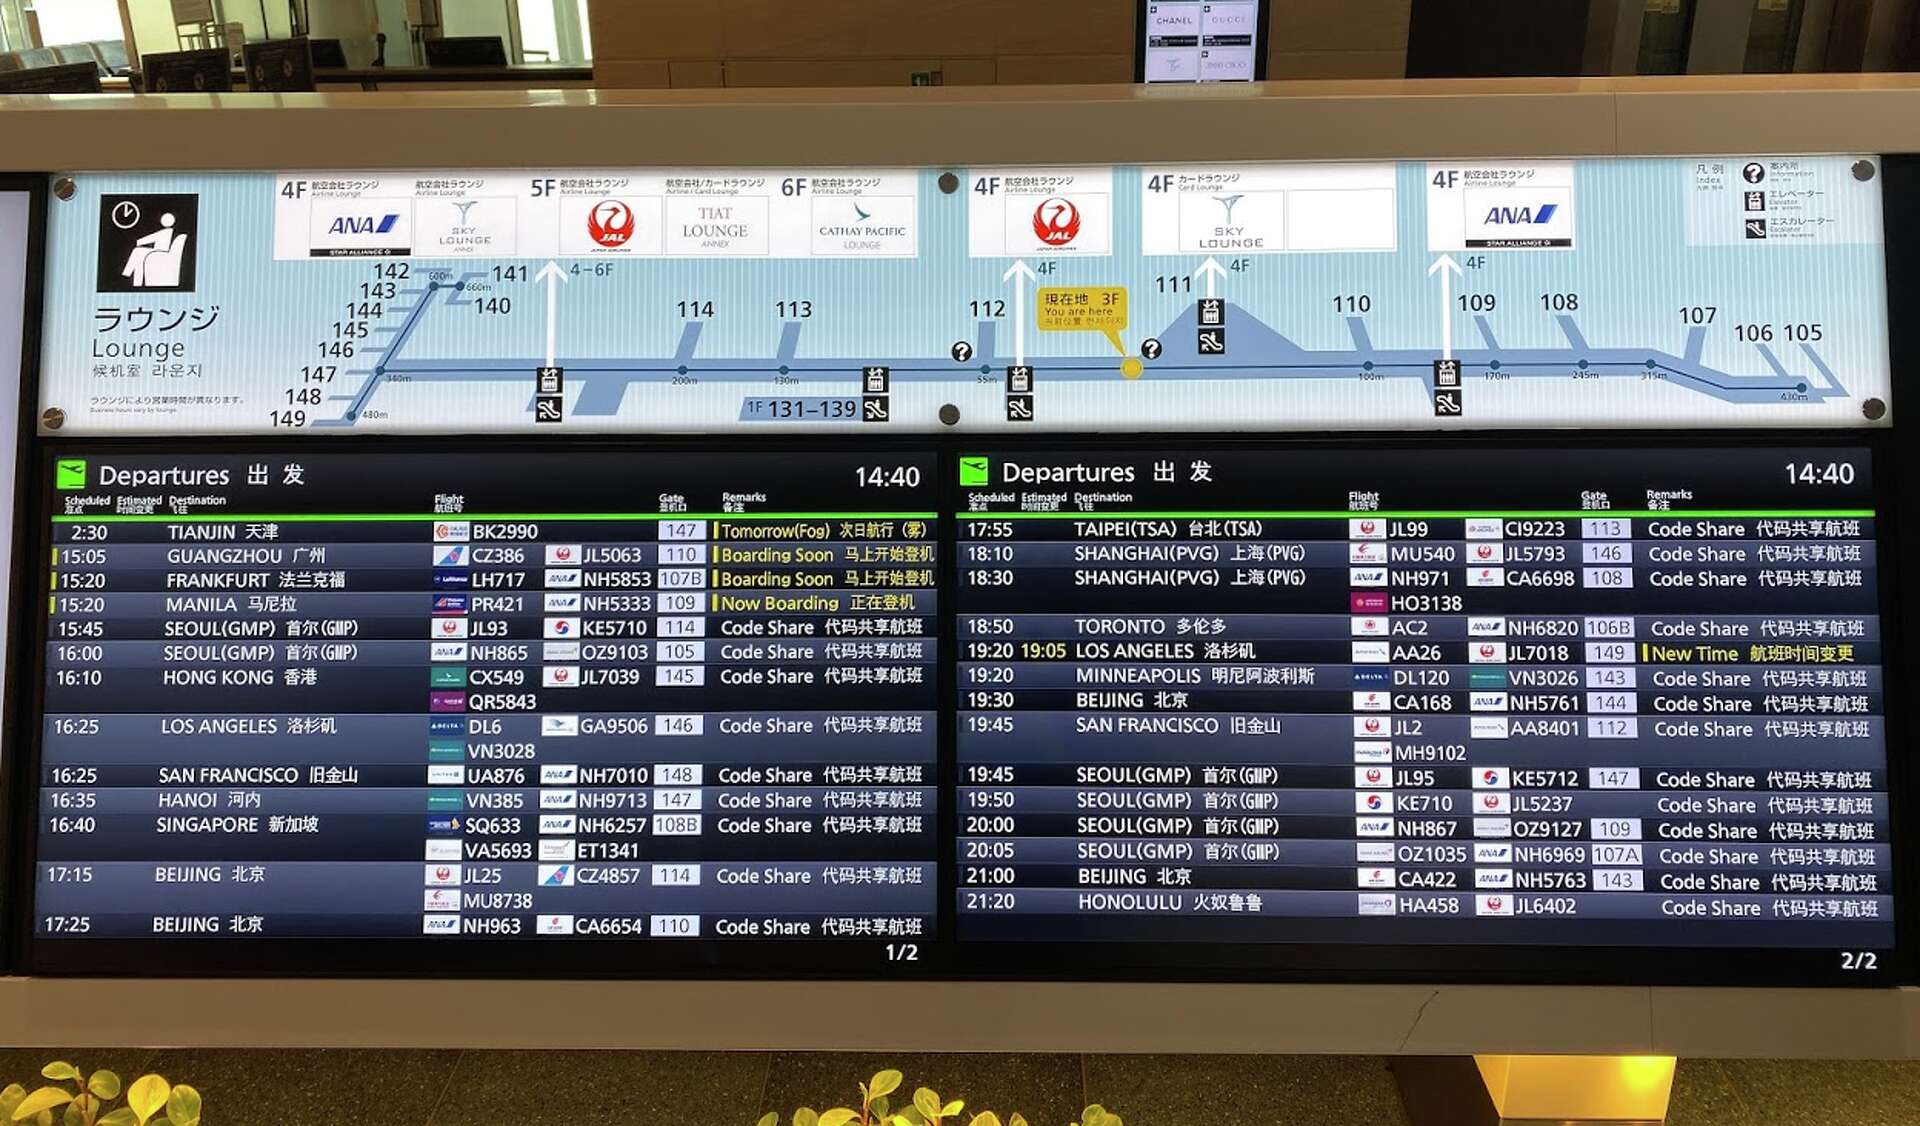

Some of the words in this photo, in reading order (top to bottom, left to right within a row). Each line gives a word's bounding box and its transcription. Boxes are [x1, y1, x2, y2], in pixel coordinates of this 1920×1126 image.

[1156, 17, 1193, 25] CHANEL
[1211, 16, 1246, 24] GUCCI
[1004, 176, 1075, 186] 航空会社ラウンジ
[1178, 173, 1241, 184] カードラウンジ
[1432, 170, 1459, 188] 4F
[1463, 169, 1535, 180] 航空会社ラウンジ
[281, 181, 307, 199] 4F
[311, 180, 380, 190] 航空会社ラウンジ
[415, 179, 485, 189] 航空会社ラウンジ
[531, 179, 556, 197] 5F
[560, 179, 629, 188] 航空会社ラウンジ
[781, 179, 807, 197] 6F
[811, 178, 881, 188] 航空会社ラウンジ
[974, 177, 1000, 195] 4F
[1147, 175, 1174, 193] 4F
[698, 207, 733, 220] TIAT
[1484, 206, 1531, 224] ANA
[328, 217, 375, 234] ANA
[452, 227, 476, 235] SKY
[682, 224, 748, 238] LOUNGE
[819, 227, 862, 236] CATHAY
[865, 227, 906, 236] PACIFIC
[1214, 227, 1245, 237] SKY
[439, 236, 491, 245] LOUNGE
[600, 233, 626, 242] JAL
[700, 239, 730, 248] ANNEX
[1045, 231, 1071, 240] JAL
[1199, 237, 1264, 249] LOUNGE
[843, 240, 881, 250] LOUNGE
[1037, 262, 1057, 276] 4F
[1230, 259, 1250, 273] 4F
[1466, 256, 1485, 270] 4F
[374, 263, 410, 280] 142
[493, 265, 527, 281] 141
[361, 282, 396, 299] 143
[1156, 276, 1191, 293] 111
[475, 298, 511, 315] 140
[1102, 293, 1119, 305] 3F
[1333, 295, 1371, 313] 110
[1458, 294, 1496, 312] 109
[1540, 293, 1579, 311] 108
[347, 303, 383, 319] 144
[677, 301, 714, 318] 114
[776, 301, 812, 318] 113
[969, 300, 1005, 317] 112
[1045, 307, 1064, 316] You
[1088, 307, 1113, 316] here
[1679, 307, 1717, 324] 107
[94, 305, 220, 333] ラウンジ
[333, 322, 368, 338] 145
[1735, 325, 1773, 342] 106
[1784, 324, 1823, 342] 105
[92, 338, 185, 362] Lounge
[318, 342, 354, 358] 146
[92, 363, 141, 378] 候机室
[152, 363, 203, 378] 라운지
[301, 366, 336, 383] 147
[1572, 371, 1599, 380] 245m
[672, 377, 698, 385] 200m
[774, 377, 799, 385] 130m
[286, 389, 321, 405] 148
[747, 401, 763, 413] 1F
[270, 411, 306, 428] 149
[100, 467, 230, 488] Departures
[855, 466, 921, 487] 14:40
[1003, 463, 1135, 484] Departures
[1786, 463, 1855, 485] 14:40
[64, 496, 111, 506] Scheduled
[117, 496, 163, 505] Estimated
[169, 496, 227, 506] Destination
[434, 494, 465, 506] Flight
[659, 492, 684, 503] Gate
[722, 492, 766, 502] Remarks
[71, 525, 108, 540] 2:30
[168, 525, 236, 540] TIANJIN
[246, 524, 279, 541] 天津
[473, 523, 539, 540] BK2990
[666, 523, 697, 538] 147
[722, 523, 831, 541] Tomorrow(Fog)
[968, 522, 1013, 538] 17:55
[1074, 521, 1177, 539] TAIPEI(TSA)
[1188, 520, 1263, 538] 台北(TSA)
[1389, 521, 1428, 538] JL99
[1505, 521, 1566, 537] CI9223
[1590, 521, 1622, 536] 113
[1074, 545, 1220, 563] SHANGHAI(PVG)
[1230, 545, 1306, 562] 上海(PVG)
[61, 573, 106, 588] 15:20
[167, 573, 270, 588] FRANKFURT
[279, 572, 345, 589] 法兰克福
[472, 571, 525, 587] LH717
[660, 571, 701, 586] 107B
[722, 571, 791, 588] Boarding
[796, 571, 833, 586] Soon
[845, 570, 935, 587] 马上开始登机
[166, 597, 237, 612] MANILA
[247, 596, 297, 613] 马尼拉
[471, 596, 523, 612] PR421
[722, 596, 759, 611] Now
[764, 596, 839, 614] Boarding
[850, 595, 916, 612] 正在登机
[1391, 595, 1463, 611] HO3138
[968, 643, 1014, 659] 19:20
[1021, 643, 1067, 659] 19:05
[1076, 643, 1109, 659] LOS
[1113, 643, 1194, 659] ANGELES
[1204, 642, 1256, 659] 洛杉矶
[1392, 645, 1441, 661] AA26
[1508, 645, 1569, 661] JL7018
[1652, 645, 1690, 662] New
[1696, 645, 1738, 662] Time
[1750, 643, 1854, 662] 航班时间变更
[163, 670, 216, 685] HONG
[222, 670, 274, 685] KONG
[283, 668, 317, 686] 香港
[469, 669, 524, 685] CX549
[52, 768, 97, 783] 16:25
[159, 768, 194, 783] SAN
[200, 768, 299, 783] FRANCISCO
[309, 767, 358, 784] 旧金山
[468, 768, 525, 784] UA876
[157, 817, 259, 833] SINGAPORE
[268, 816, 319, 833] 新加坡
[466, 818, 521, 834] SQ633
[967, 893, 1014, 910] 21:20
[1079, 894, 1182, 910] HONOLULU
[1193, 893, 1263, 911] 火奴鲁鲁
[1400, 896, 1459, 913] HA458
[1516, 898, 1576, 915] JL6402
[45, 917, 90, 932] 17:25
[153, 917, 219, 932] BEIJING
[229, 916, 264, 933] 北京
[463, 919, 521, 935] NH963
[576, 919, 642, 935] CA6654
[659, 919, 690, 934] 110
[716, 919, 759, 935] Code
[764, 919, 810, 935] Share
[821, 918, 922, 935] 代码共享航班
[885, 944, 918, 961] 1/2
[1841, 952, 1878, 970] 2/2
